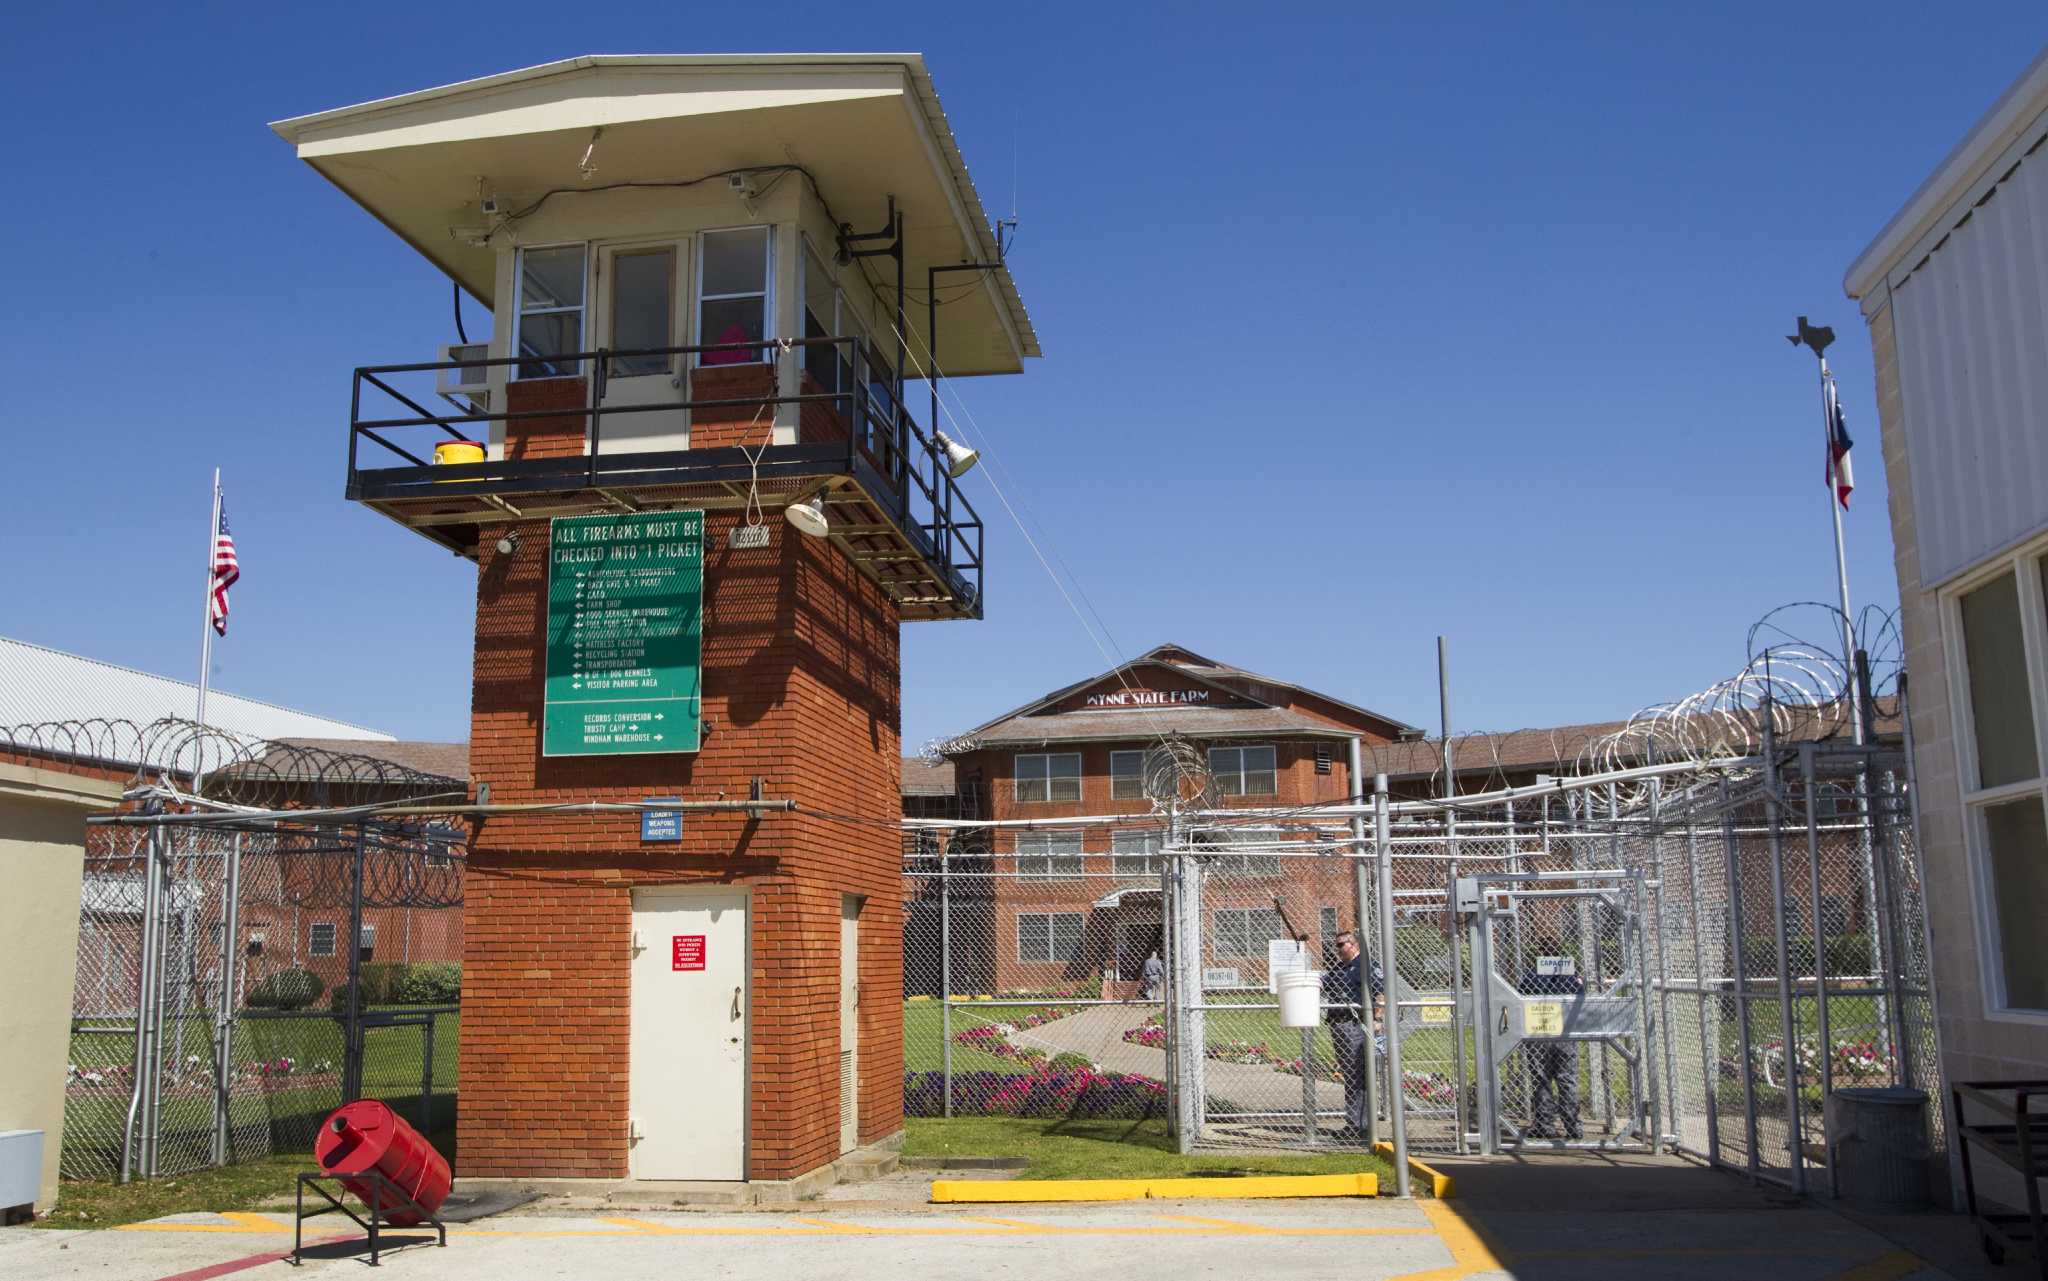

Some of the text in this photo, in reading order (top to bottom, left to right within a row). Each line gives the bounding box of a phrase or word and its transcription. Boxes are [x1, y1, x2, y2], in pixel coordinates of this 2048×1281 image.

[556, 521, 699, 543] ALL FIREARMS MUST BE
[555, 546, 604, 563] CHECKED
[611, 545, 636, 560] INTO
[658, 542, 698, 558] PICKET
[587, 600, 622, 609] FARM SHOP
[618, 640, 644, 648] FACTORY
[586, 649, 645, 659] RECYCLING STATION
[586, 659, 636, 669] TRANSPORTATION
[610, 670, 622, 678] DOG
[624, 668, 651, 677] KENNELS
[587, 679, 658, 688] VISITOR PARKING AREA
[1087, 690, 1209, 705] WYNNE STATE FARM
[584, 713, 652, 722] RECORDS CONVERSION
[584, 724, 625, 733] TRUSTY CAMP
[584, 734, 650, 744] WINDHAM WAREHOUSE
